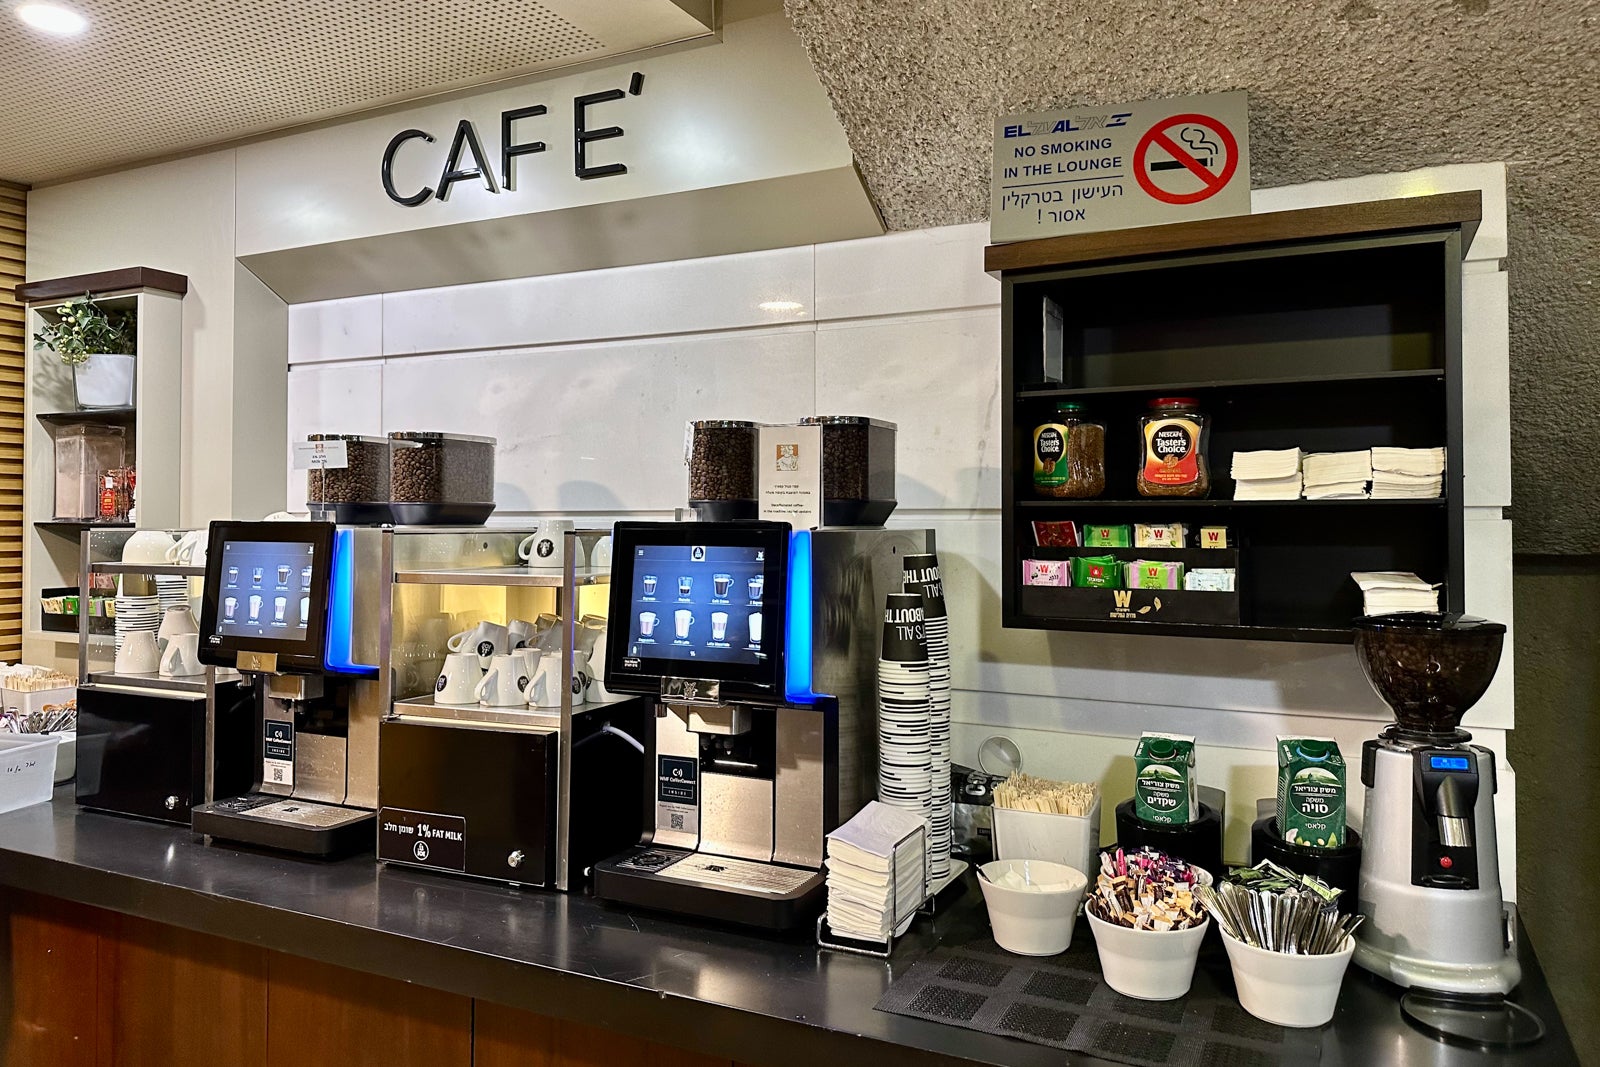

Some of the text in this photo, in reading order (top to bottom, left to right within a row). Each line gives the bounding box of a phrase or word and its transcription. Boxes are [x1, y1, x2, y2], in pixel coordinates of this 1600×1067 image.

[1014, 138, 1112, 158] NO SMOKING
[1004, 156, 1122, 178] IN THE LOUNGE
[1002, 184, 1123, 210] העישון בטרקלין
[1048, 208, 1085, 222] אסור
[1155, 438, 1187, 447] Taster's
[1157, 445, 1187, 453] Choice
[1113, 590, 1132, 607] W
[895, 625, 914, 640] ALL
[1147, 796, 1176, 807] שקדים
[1302, 803, 1329, 813] סויה
[1152, 815, 1172, 823] קלאסי
[383, 821, 414, 835] שומן חלב
[417, 823, 463, 841] 1% FAT MILK
[1305, 822, 1326, 831] קלאסי
